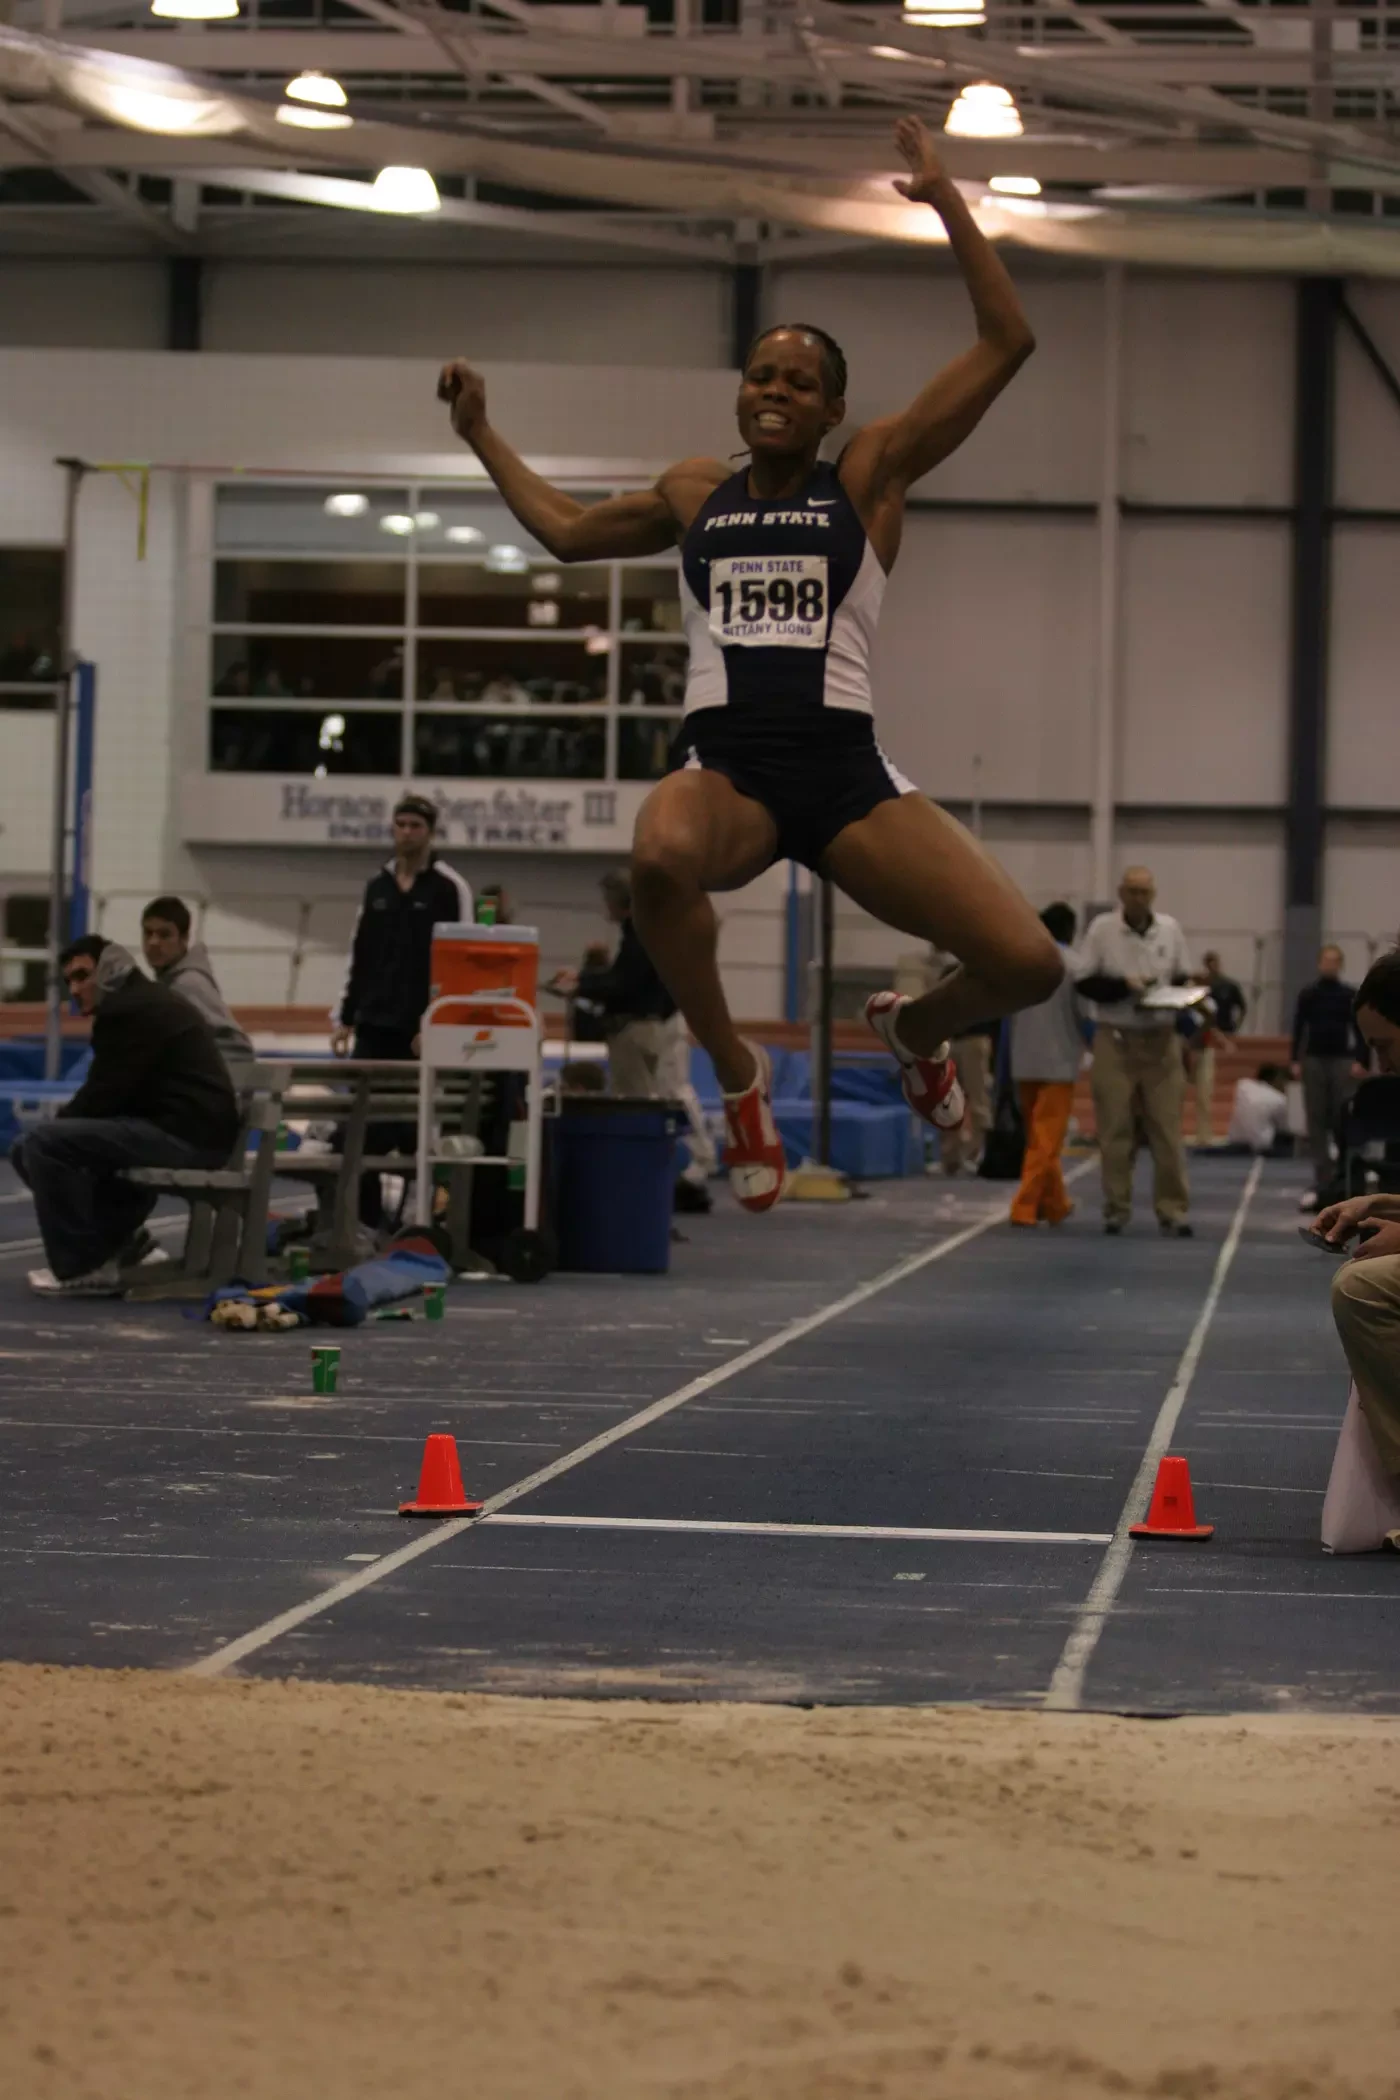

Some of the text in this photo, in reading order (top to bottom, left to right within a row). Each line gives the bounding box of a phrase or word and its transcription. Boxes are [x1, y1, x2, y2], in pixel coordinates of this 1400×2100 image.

[704, 511, 831, 532] PENN STATE
[731, 560, 804, 574] PENN STATE
[715, 578, 824, 625] 1598
[776, 623, 812, 637] LIONS
